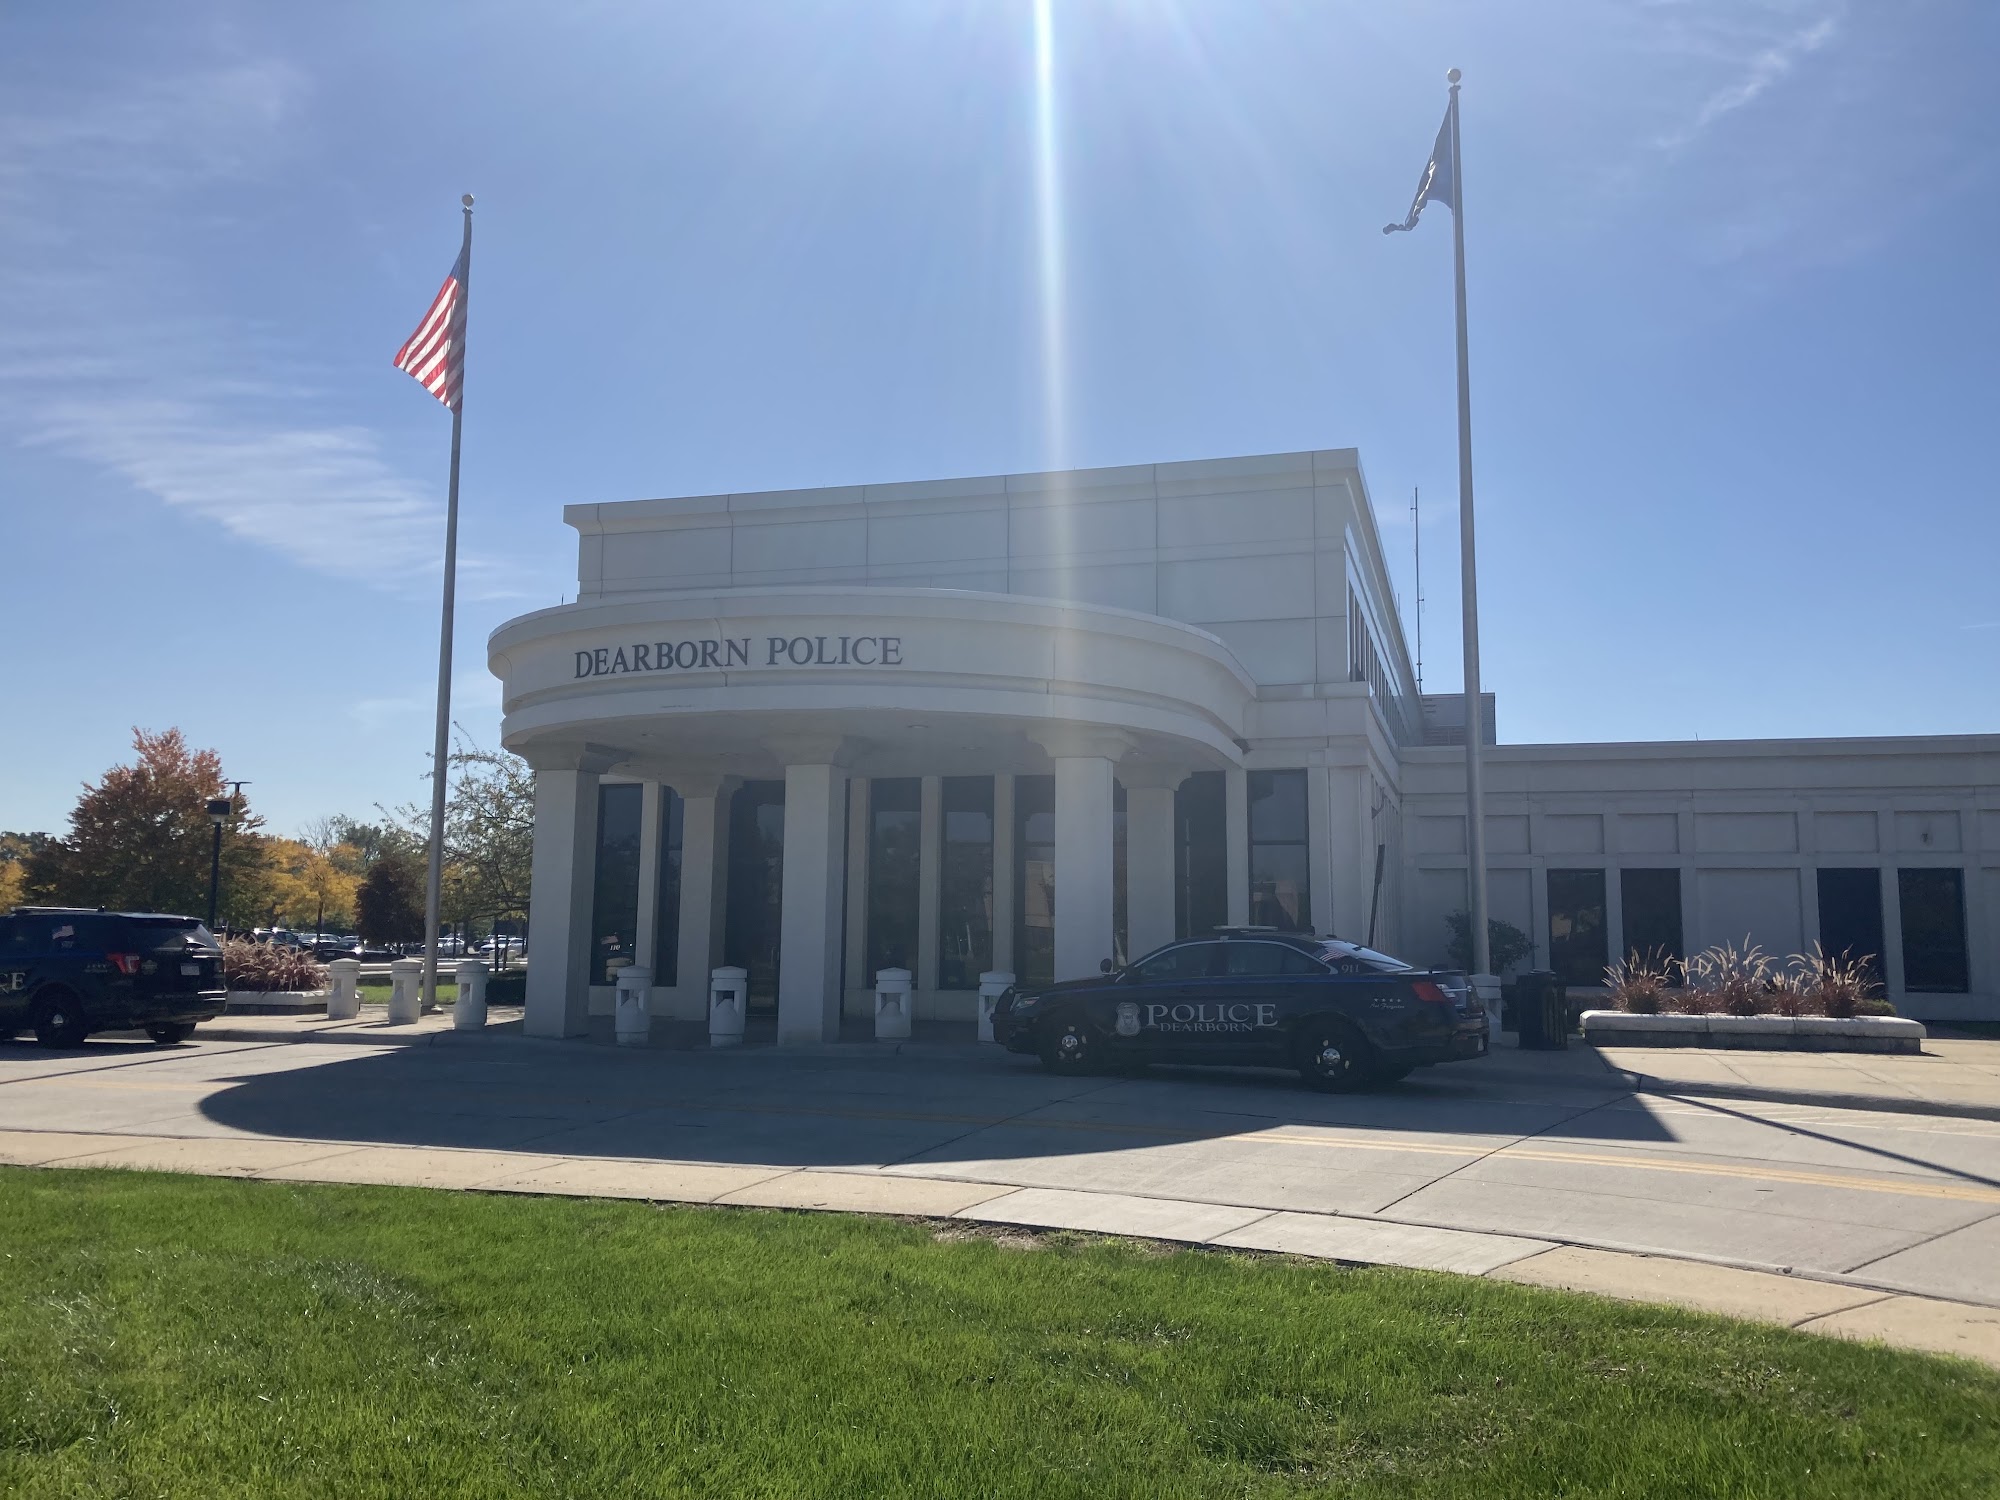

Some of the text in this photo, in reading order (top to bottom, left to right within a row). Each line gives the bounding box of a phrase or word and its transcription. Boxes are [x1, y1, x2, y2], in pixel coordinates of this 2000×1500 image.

[574, 636, 903, 679] DEARBORN POLICE
[1144, 1003, 1279, 1027] POLICE
[1160, 1022, 1253, 1032] DEARBORN
